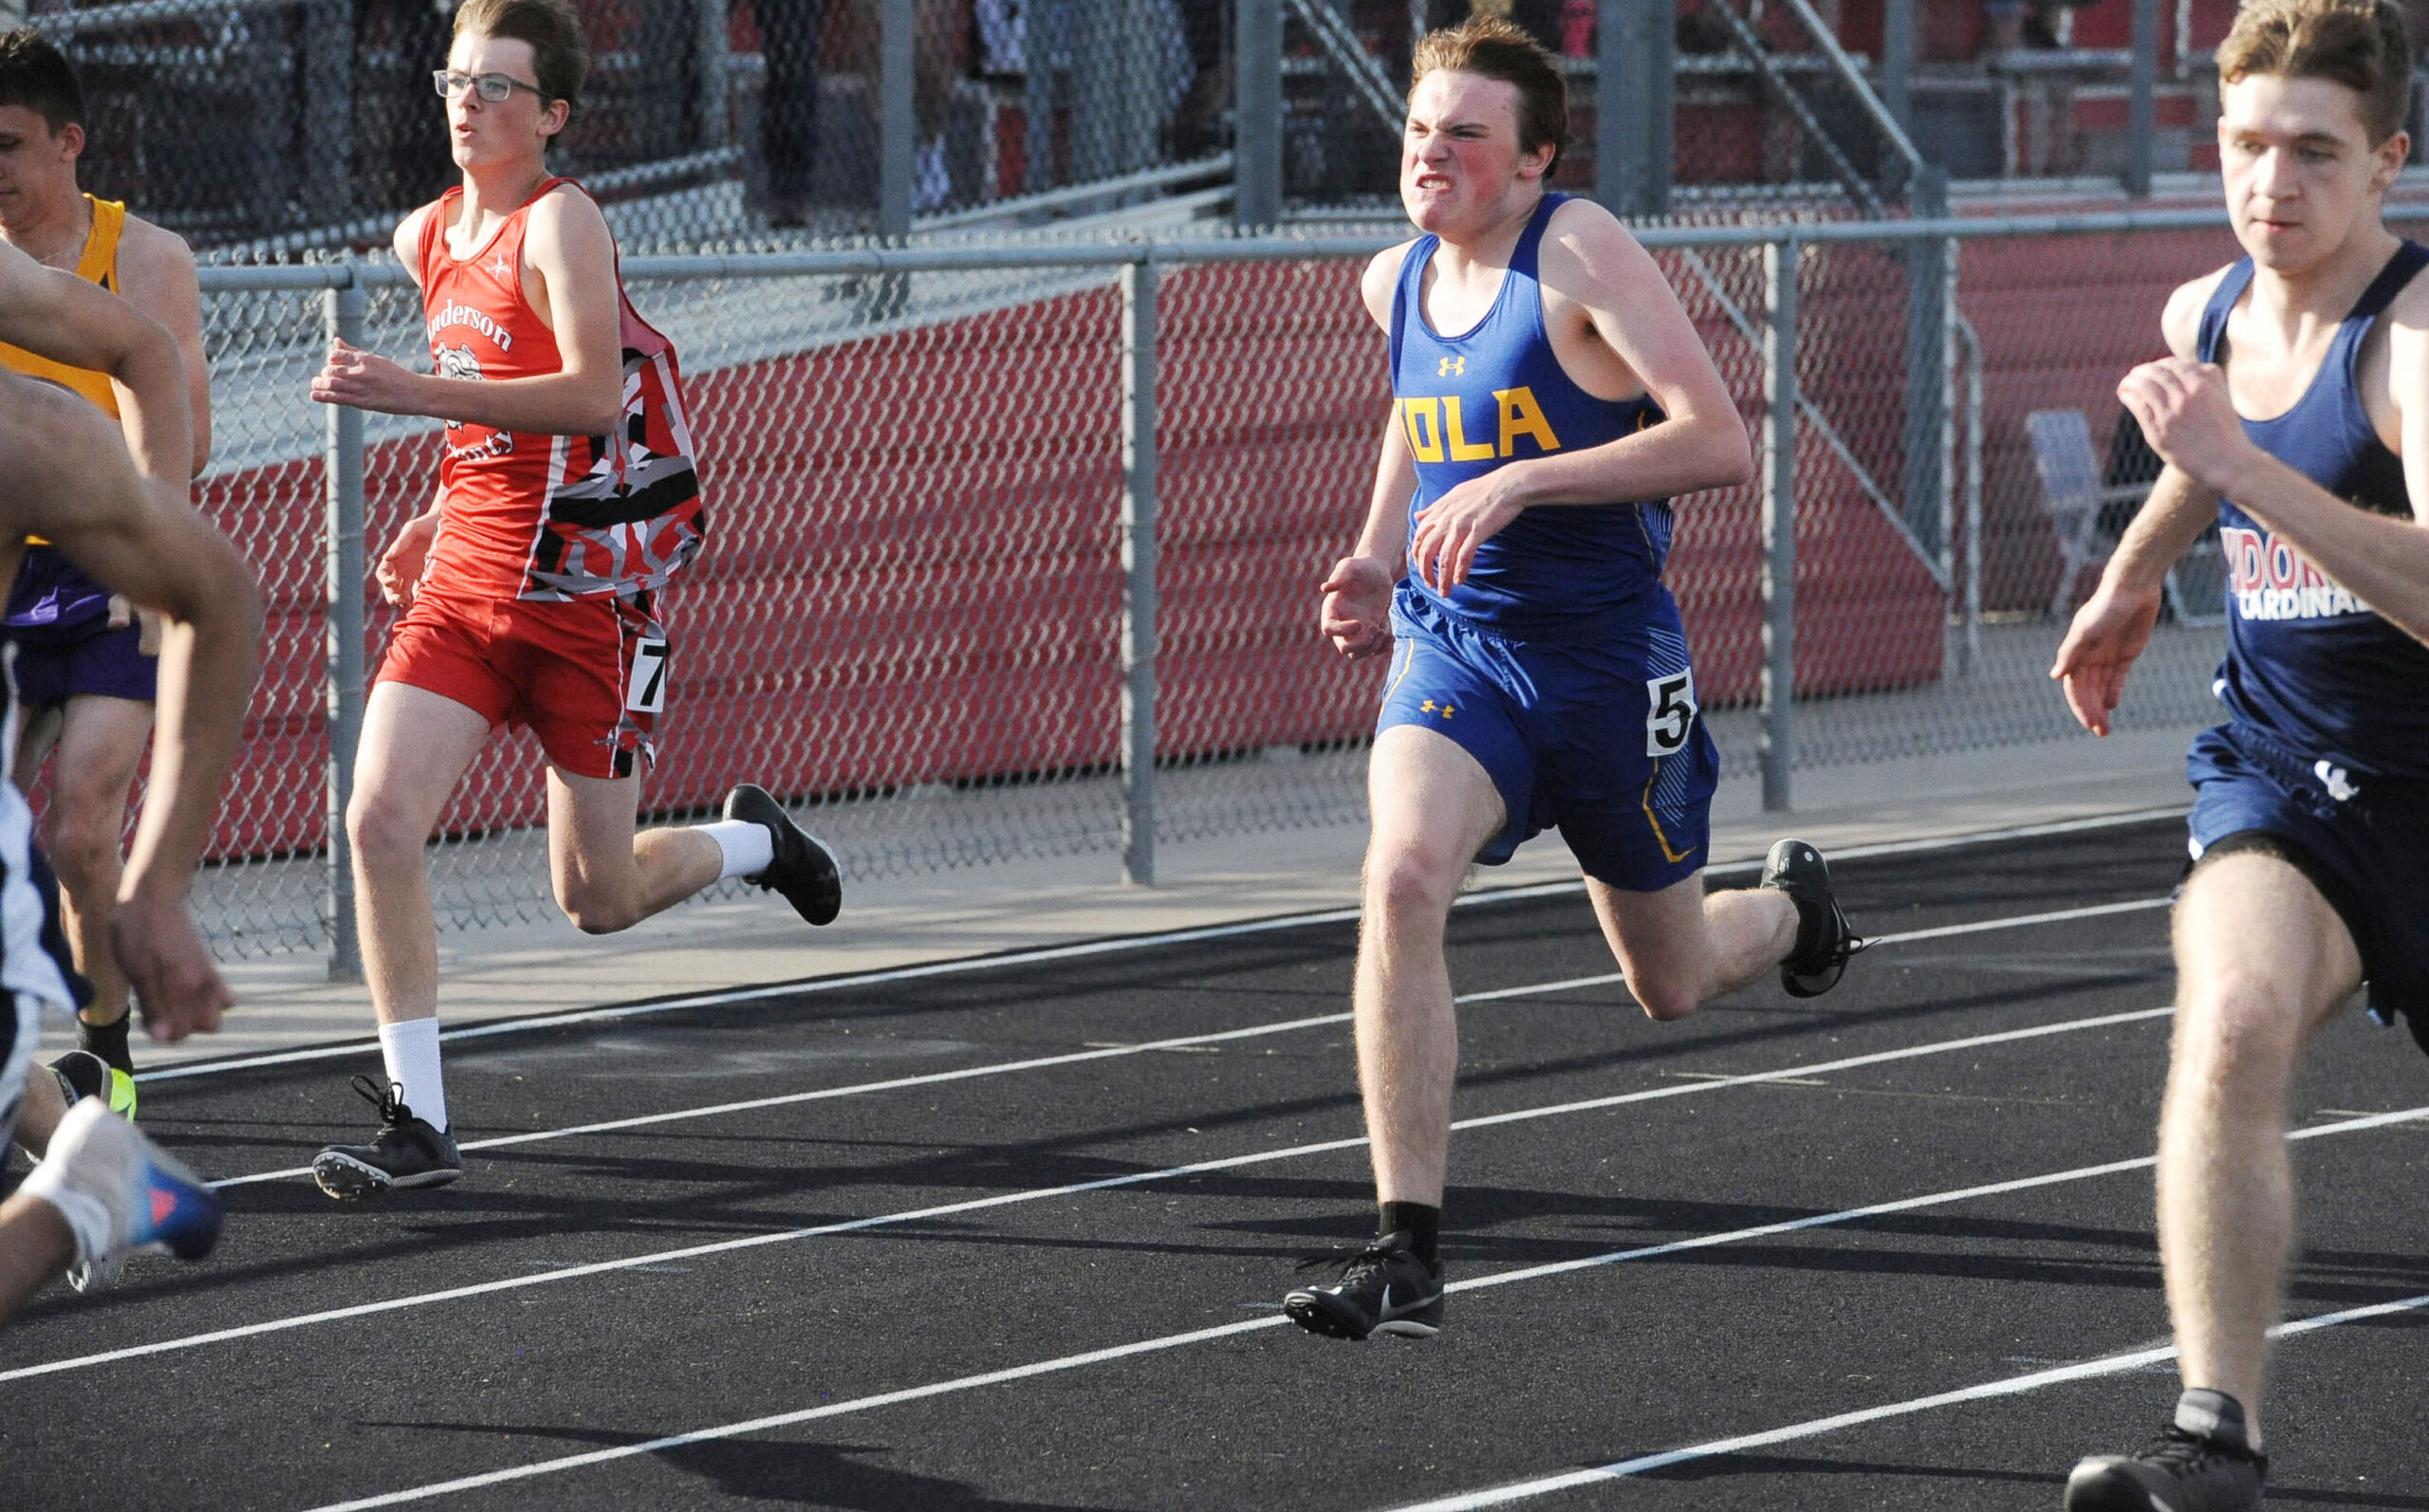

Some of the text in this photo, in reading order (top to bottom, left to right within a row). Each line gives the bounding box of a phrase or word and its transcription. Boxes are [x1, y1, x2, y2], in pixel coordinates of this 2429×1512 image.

[427, 298, 513, 353] nderson
[640, 644, 667, 707] 7
[1655, 676, 1691, 748] 5
